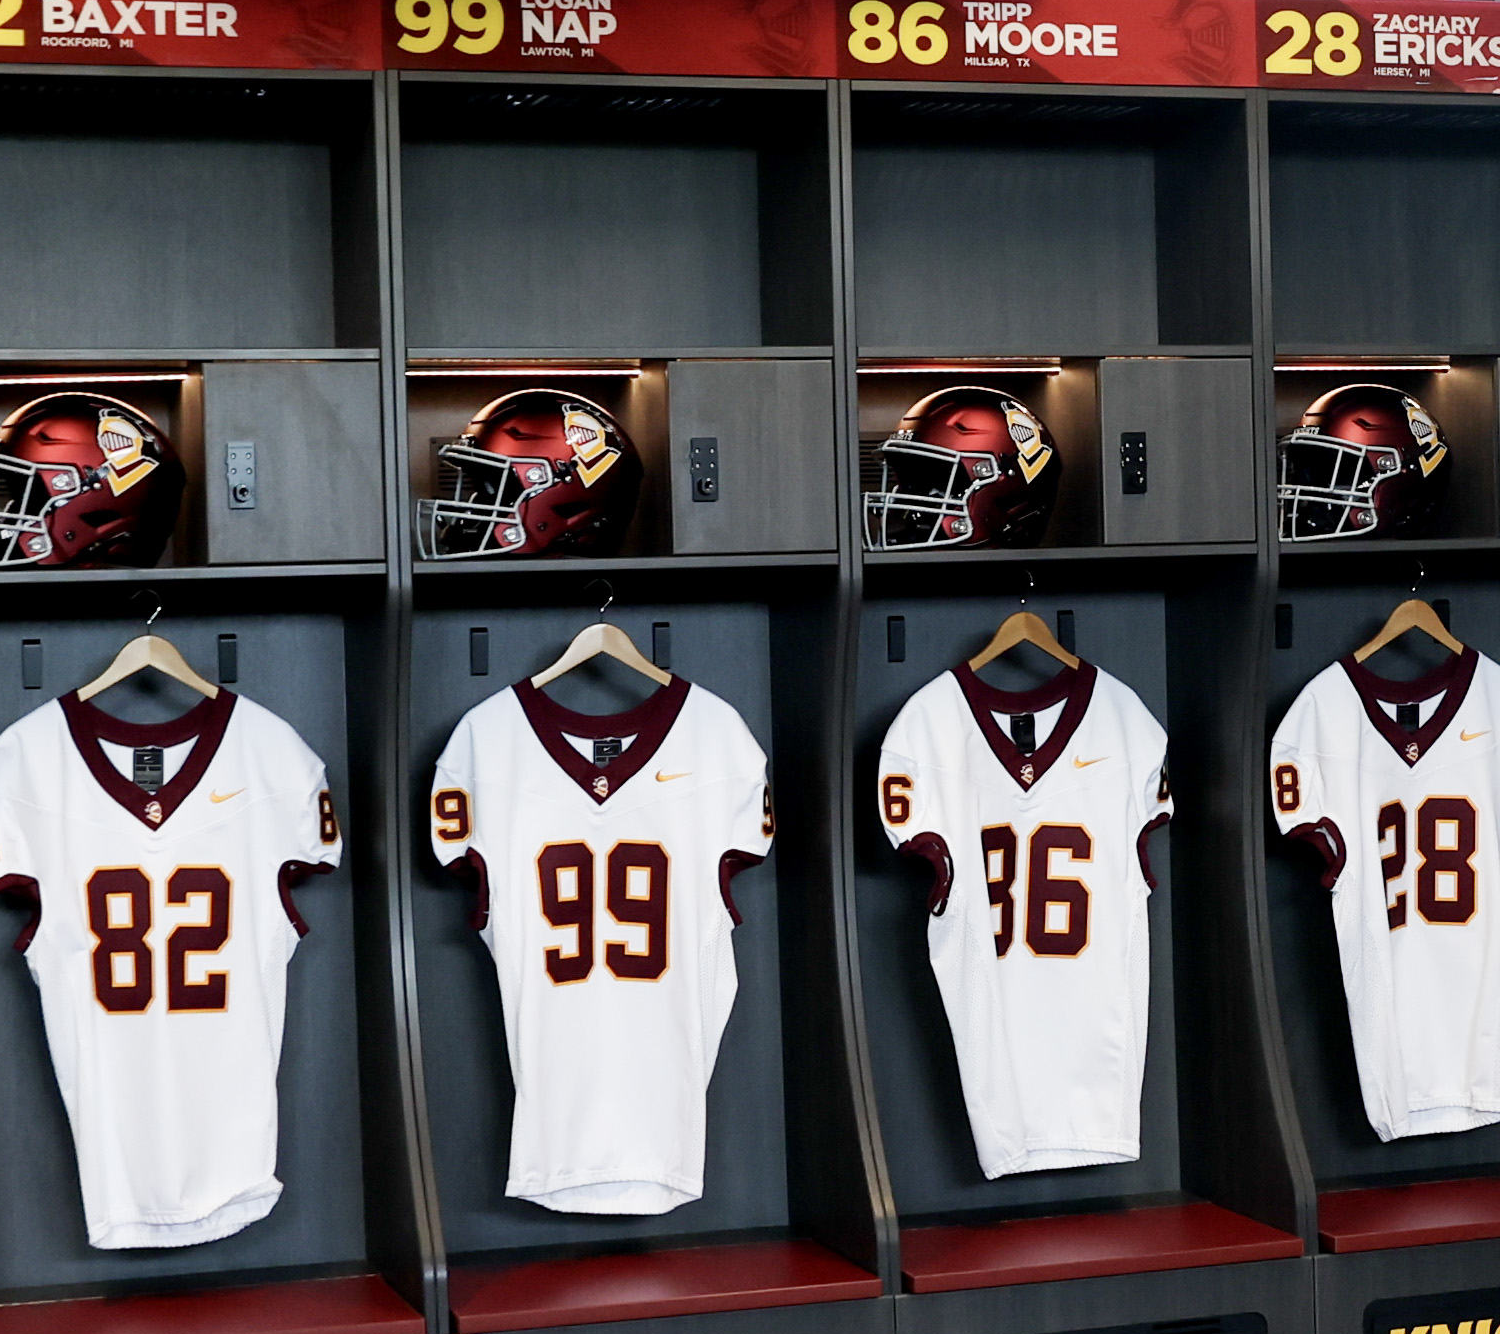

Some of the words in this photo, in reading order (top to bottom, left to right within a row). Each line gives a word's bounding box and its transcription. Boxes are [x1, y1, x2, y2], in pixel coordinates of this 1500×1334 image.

[42, 0, 239, 38] BAXTER
[522, 10, 617, 44] NAP
[963, 1, 1032, 21] TRIPP
[1373, 13, 1480, 35] ZACHARY
[41, 36, 111, 50] ROCKFORD,
[120, 38, 134, 49] MI
[847, 0, 949, 66] 86
[965, 21, 1119, 57] MOORE
[1265, 10, 1362, 76] 28
[521, 47, 574, 59] LAWTON,
[581, 48, 594, 58] MI
[964, 57, 1010, 69] MILLSAP,
[1016, 58, 1031, 67] TX
[1373, 67, 1413, 78] HERSEY,
[1420, 68, 1431, 77] MI
[880, 773, 914, 827] 6
[1271, 763, 1301, 814] 8
[430, 787, 473, 844] 9
[1377, 794, 1479, 933] 28
[535, 839, 671, 987] 99
[84, 864, 234, 1015] 82
